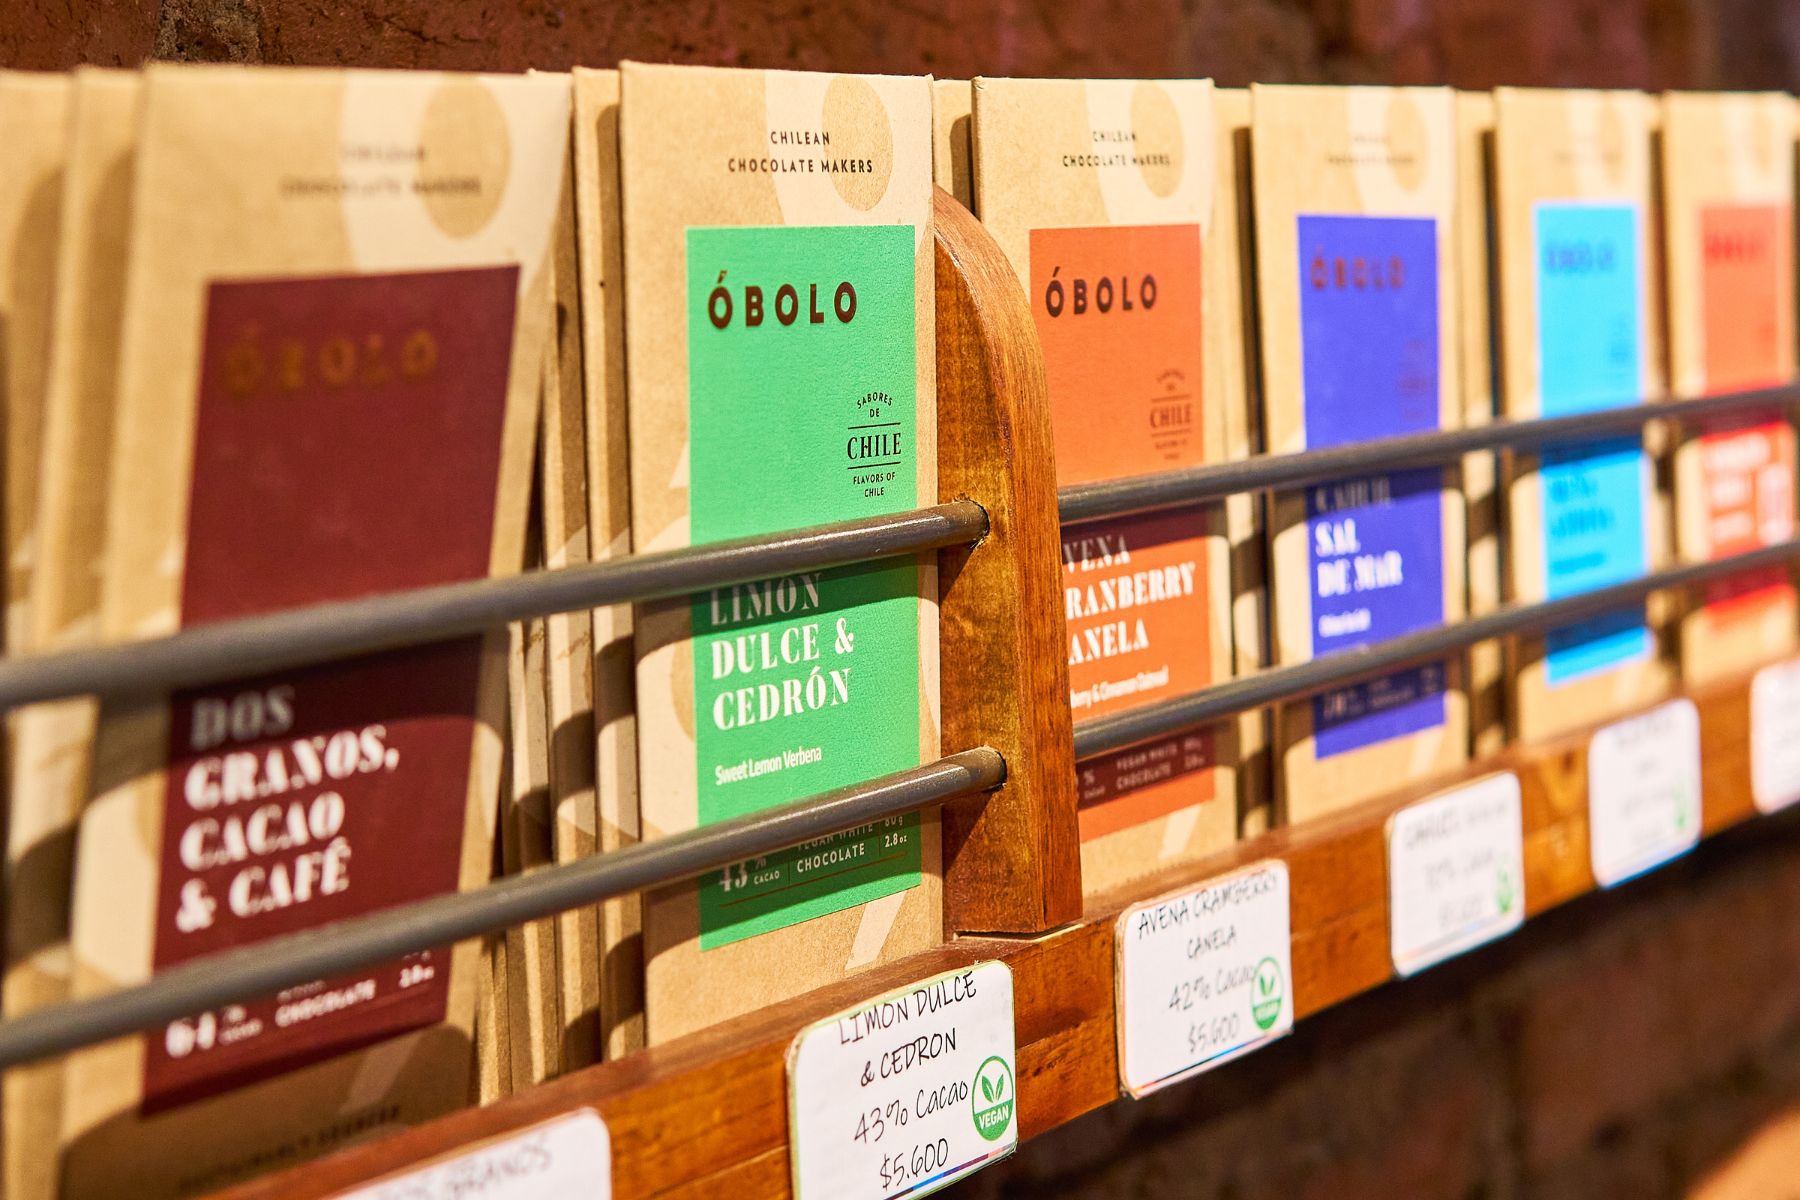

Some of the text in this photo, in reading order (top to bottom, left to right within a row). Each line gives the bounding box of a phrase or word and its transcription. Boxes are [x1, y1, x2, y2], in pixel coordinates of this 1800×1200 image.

[770, 131, 830, 145] CHILEAN
[728, 158, 873, 173] CHOCOLATE MAKERS
[1062, 154, 1126, 168] CHOCOLATE
[708, 269, 857, 330] ÓBOLO
[1045, 266, 1157, 318] ÓBOLO
[857, 392, 893, 409] SABORES
[869, 408, 880, 418] DE
[1150, 403, 1192, 428] CHILE
[847, 432, 902, 460] CHILE
[853, 471, 896, 485] FLAVORS OF
[864, 487, 884, 497] CHILE
[1063, 534, 1131, 574] VENA
[1065, 560, 1196, 621] RANBERRY
[711, 617, 855, 680] DULCE &
[1068, 617, 1149, 666] ANELA
[191, 684, 296, 750] DOS
[712, 665, 851, 731] CEDRÓN
[715, 746, 822, 786] Sweet Lemon Verbena
[179, 790, 346, 872] CACAO
[753, 869, 780, 885] CACAO
[796, 842, 865, 873] CHOCOLATE
[175, 876, 217, 933] &
[1138, 901, 1190, 941] AVENA
[1187, 923, 1237, 960] CANELA
[838, 971, 977, 1046] LIMON DULCE
[1168, 976, 1210, 1011] 42%
[860, 1027, 957, 1088] & CEDRON
[854, 1080, 969, 1144] 43% Cacao
[979, 1105, 1010, 1130] VEGAN
[879, 1137, 950, 1193] $5.600
